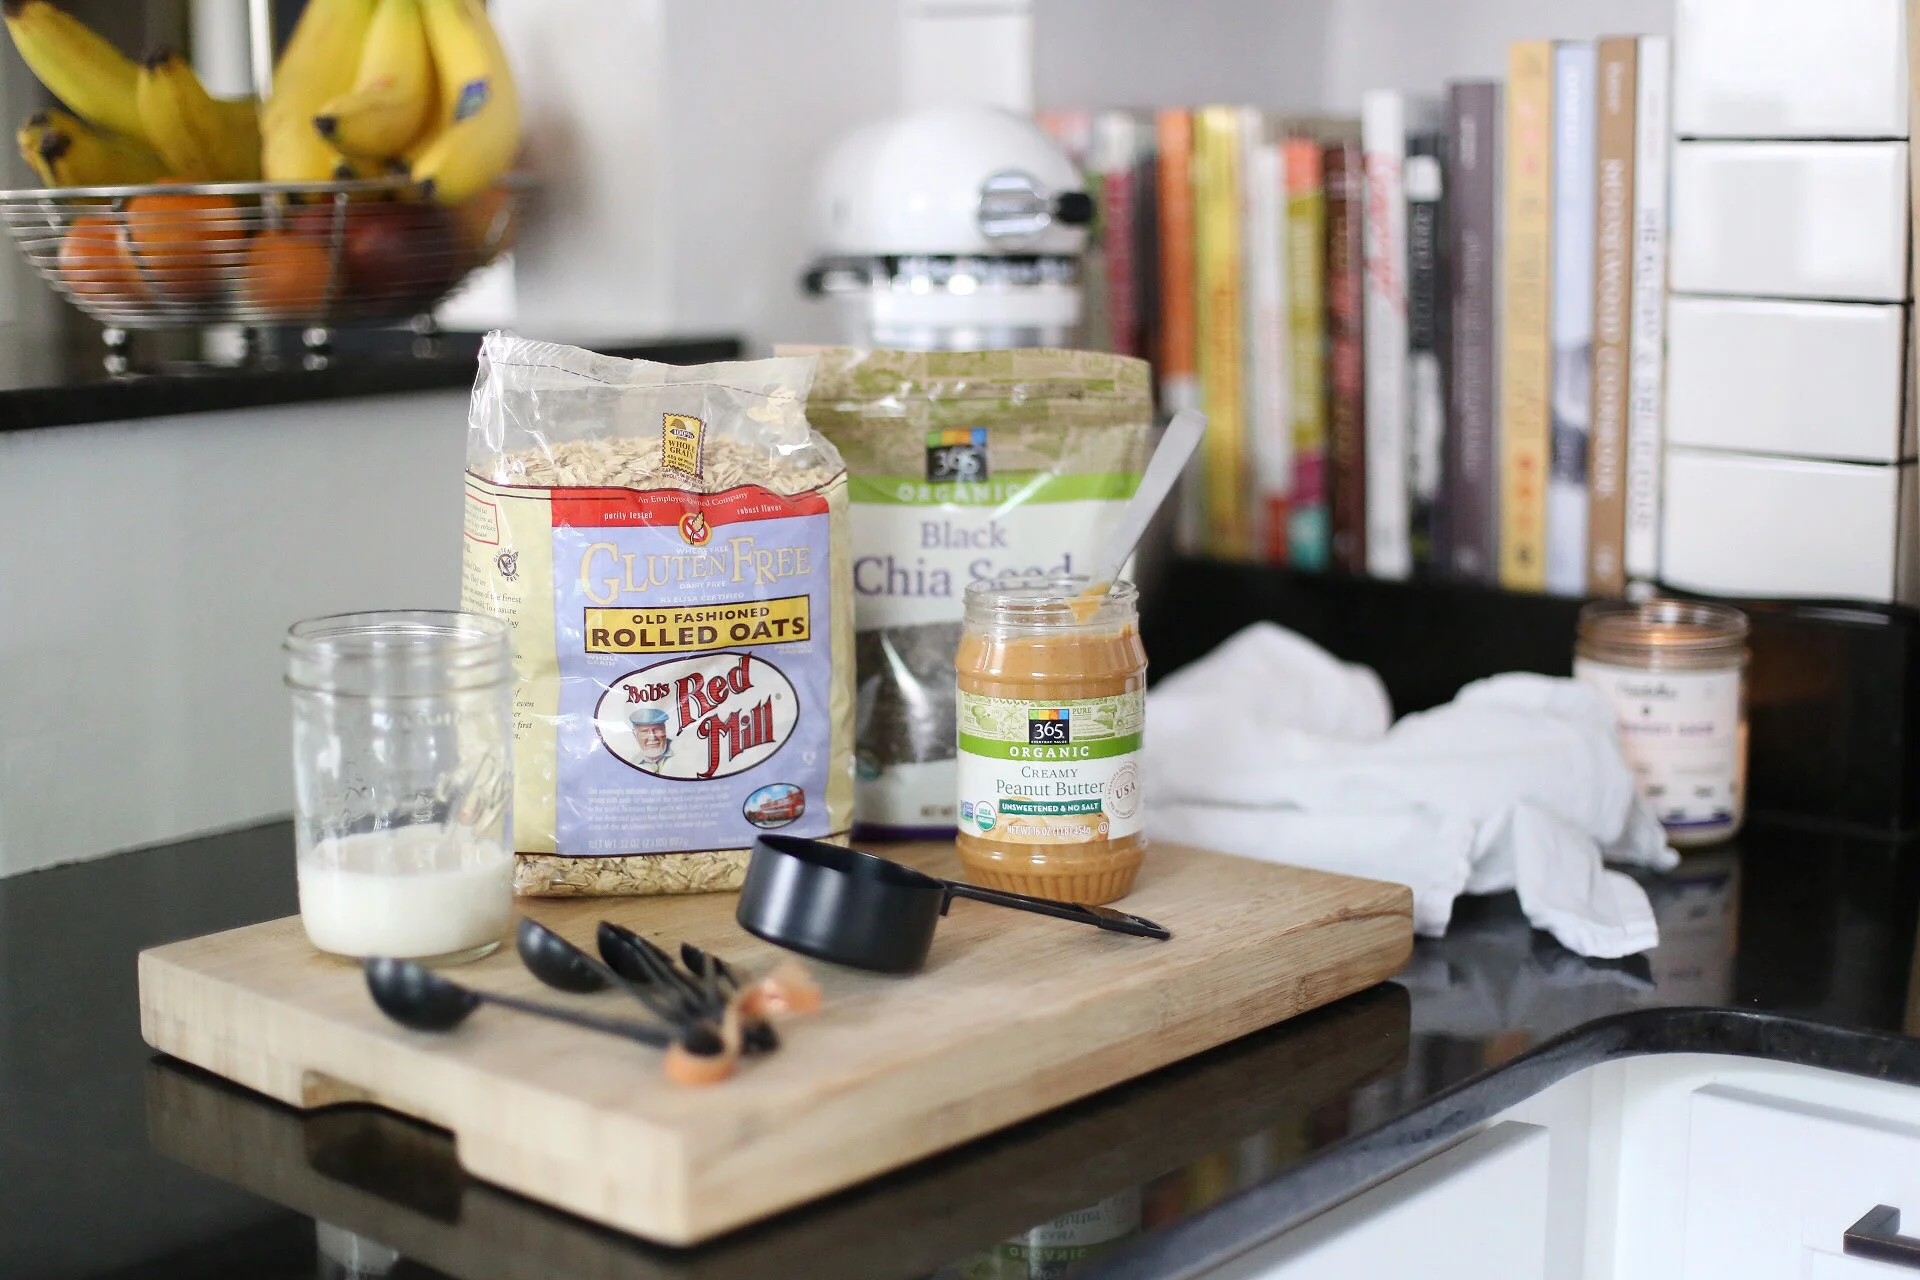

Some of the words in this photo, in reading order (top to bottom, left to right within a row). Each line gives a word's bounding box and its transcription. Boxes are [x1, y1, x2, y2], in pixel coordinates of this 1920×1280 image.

[668, 440, 695, 453] WHOLE
[670, 446, 693, 459] GRAIN
[711, 492, 749, 507] Company
[604, 511, 627, 521] purity
[629, 510, 653, 519] tested
[736, 505, 759, 515] robust
[761, 504, 782, 513] flavor
[920, 519, 1008, 550] Black
[709, 545, 729, 553] FREE
[729, 536, 812, 586] FREE
[852, 553, 953, 598] Chia
[679, 582, 705, 590] DAIRY
[706, 580, 729, 589] FREE
[502, 593, 522, 604] finest
[700, 591, 745, 602] CERTIFIED
[632, 614, 667, 625] OLD
[674, 607, 770, 624] FASHIONED
[592, 624, 718, 648] ROLLED
[729, 616, 806, 642] OATS
[586, 654, 619, 662] WHOLE
[586, 659, 616, 667] GRAIN
[623, 681, 671, 704] Bob's
[674, 650, 754, 736] Red
[1072, 707, 1092, 715] PURE
[517, 721, 533, 730] first
[1033, 721, 1064, 739] 365
[696, 693, 776, 779] Mill
[1009, 746, 1090, 758] ORGANIC
[1021, 765, 1079, 779] CREAMY
[996, 779, 1051, 796] Peanut
[1056, 780, 1105, 796] Butter
[1115, 781, 1136, 799] USA
[1002, 803, 1059, 812] UNSWEETENED
[1081, 802, 1099, 811] SALT
[1007, 825, 1019, 834] NET
[1020, 826, 1031, 835] WT
[1032, 826, 1040, 835] 16
[1041, 827, 1051, 836] OZ
[1073, 825, 1091, 835] 454g
